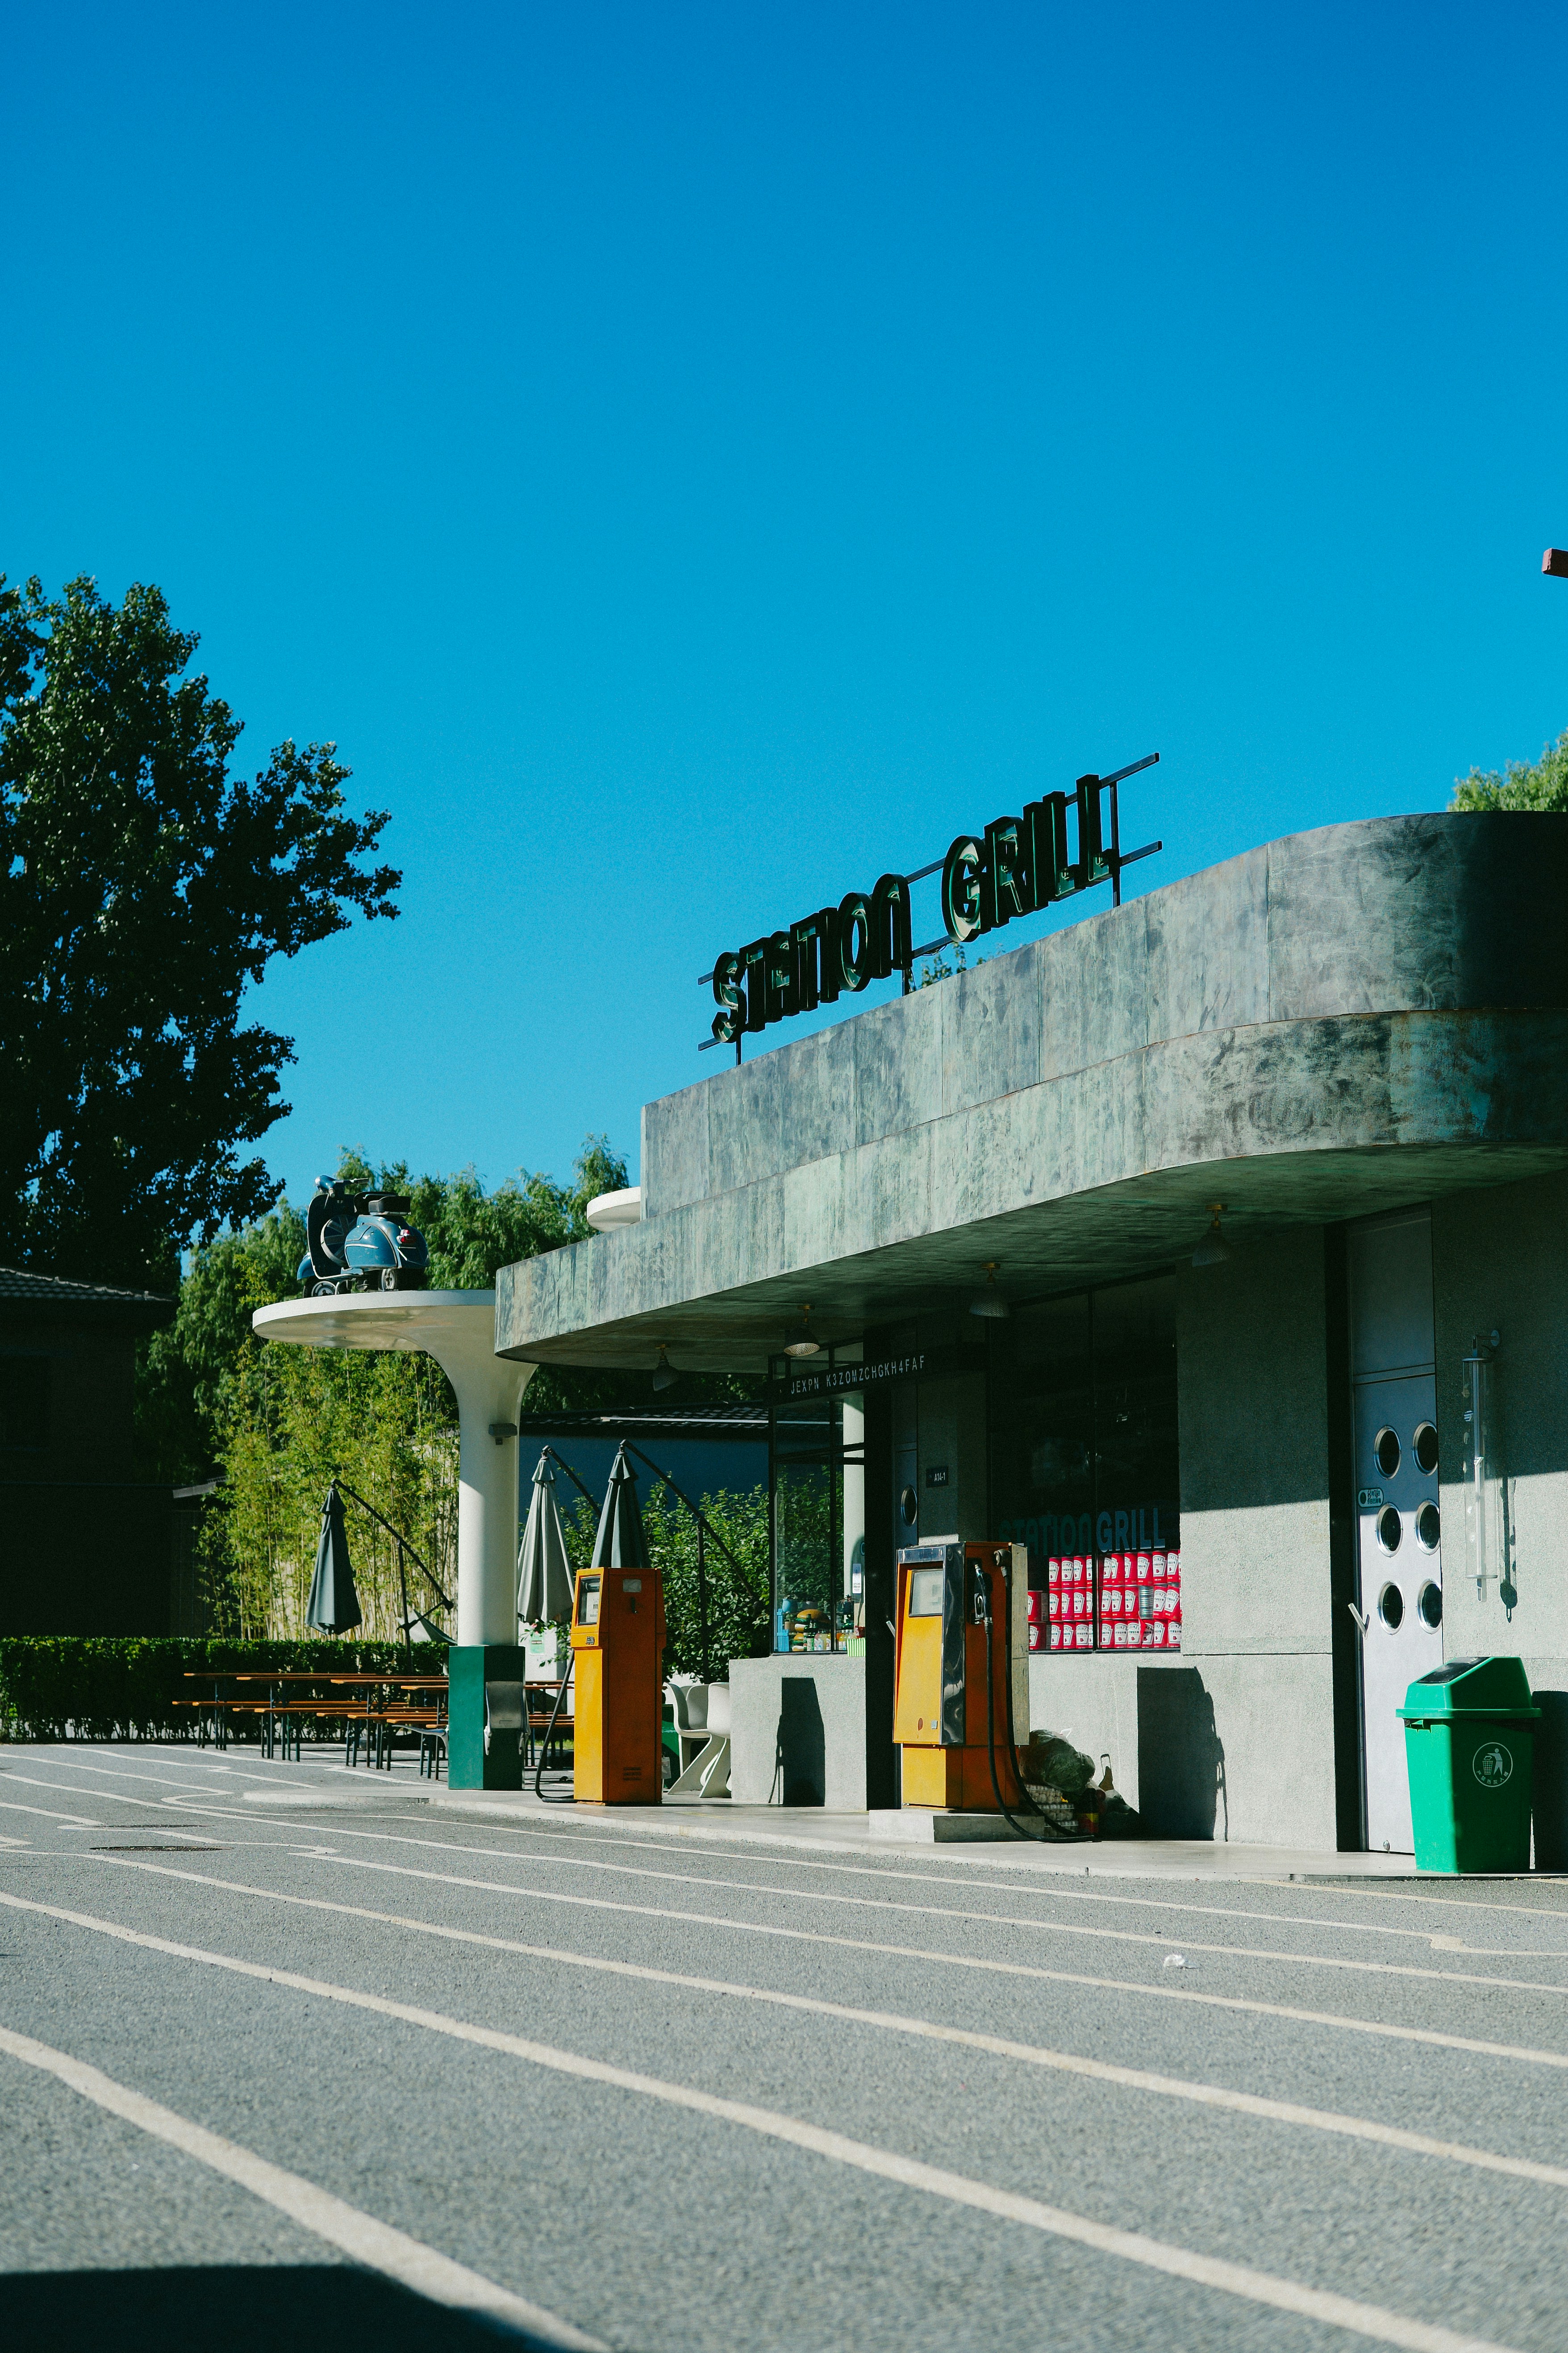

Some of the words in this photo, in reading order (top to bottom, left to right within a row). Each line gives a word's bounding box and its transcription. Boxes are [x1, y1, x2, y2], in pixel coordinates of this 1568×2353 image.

[711, 873, 913, 1043] STATION
[942, 774, 1120, 942] GRILL
[791, 1377, 819, 1394] JEXPN
[934, 1472, 946, 1482] A14-1
[998, 1513, 1092, 1555] STATION
[1096, 1508, 1165, 1553] GRILL
